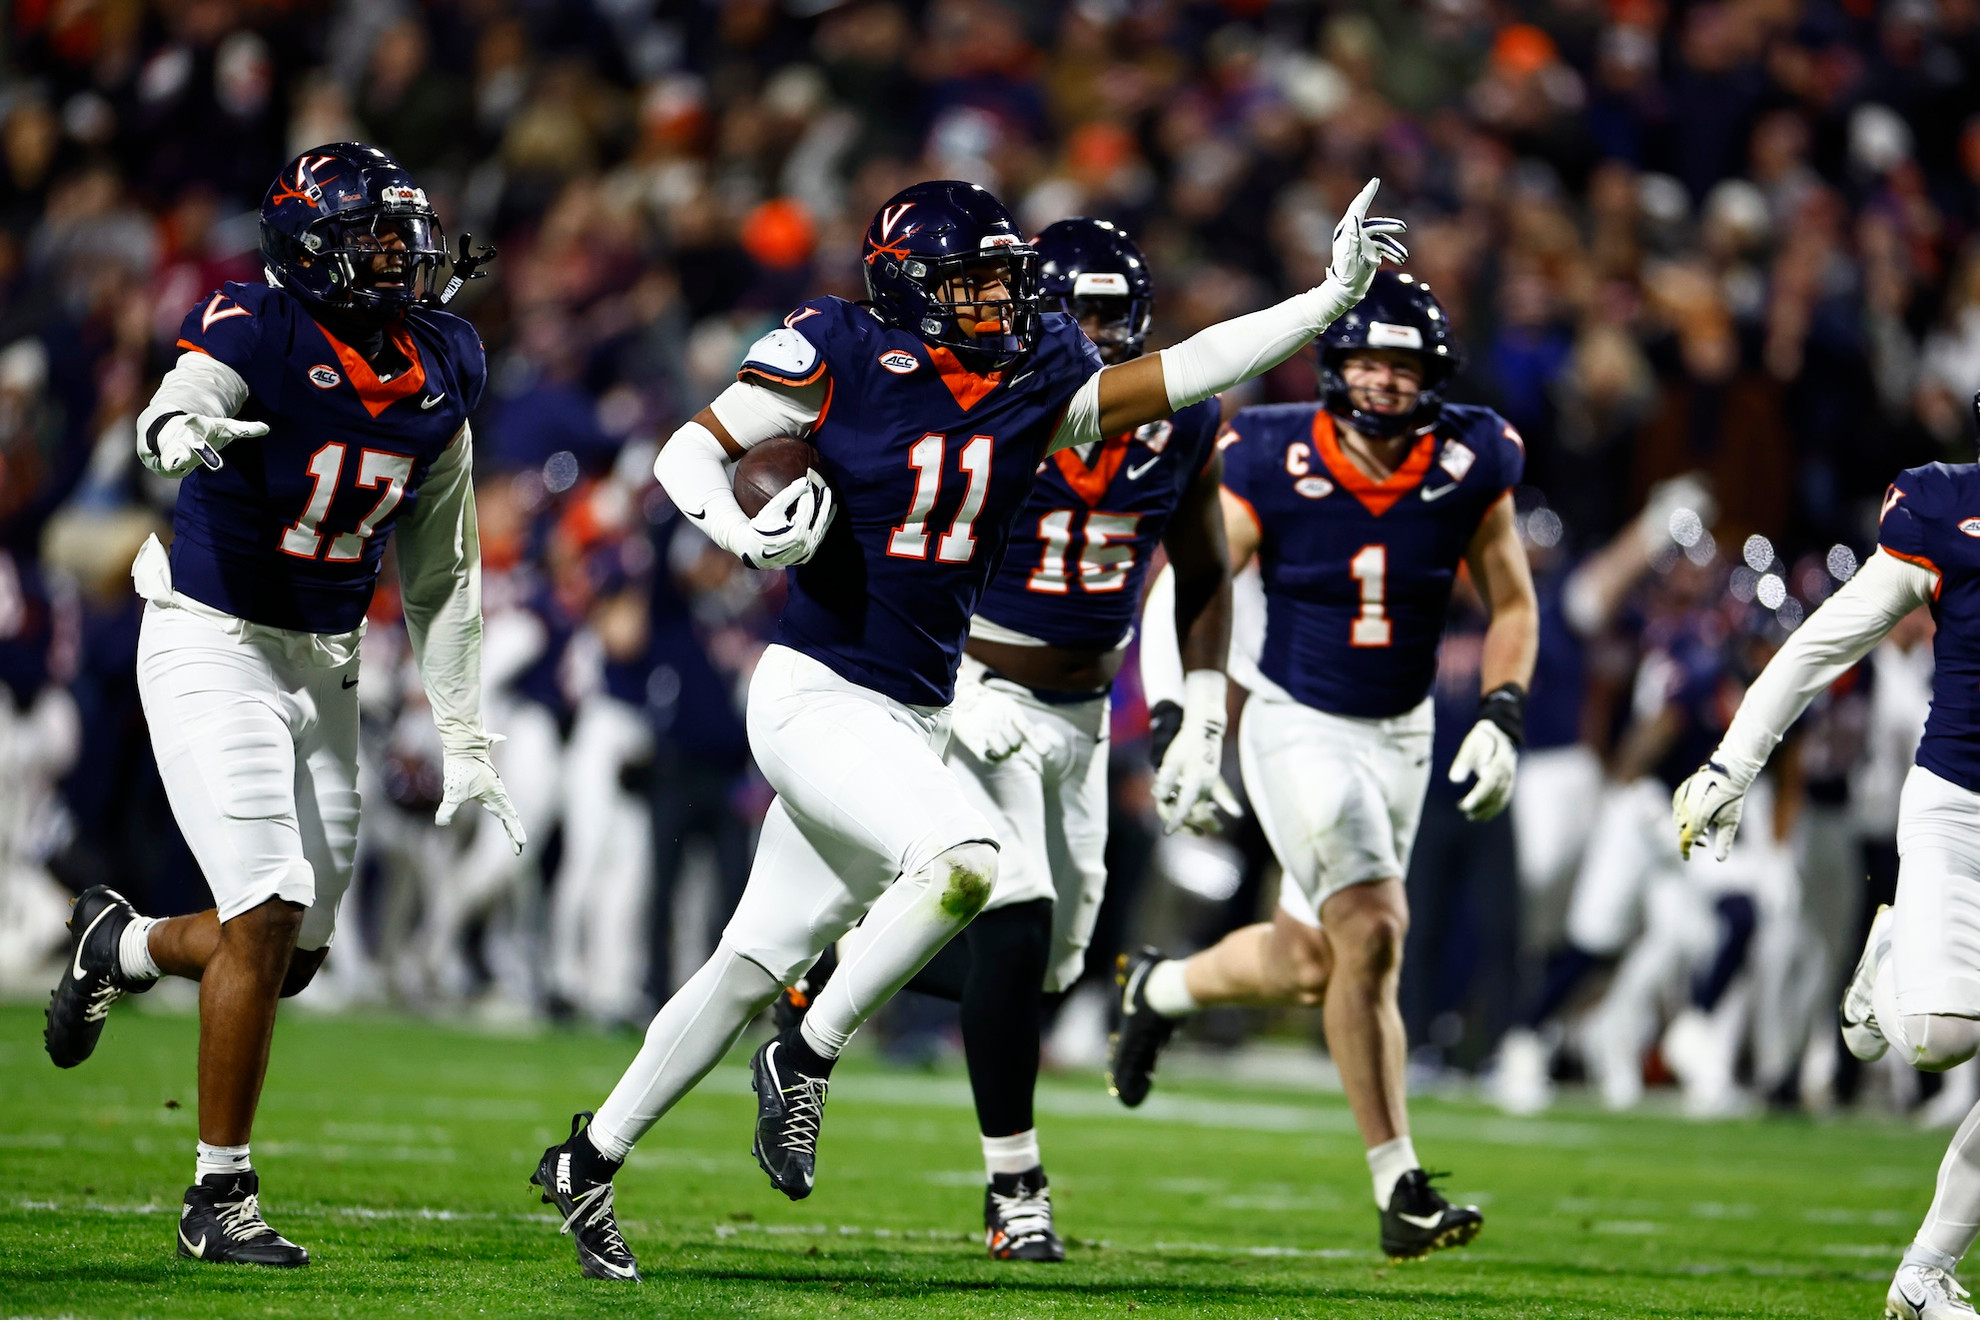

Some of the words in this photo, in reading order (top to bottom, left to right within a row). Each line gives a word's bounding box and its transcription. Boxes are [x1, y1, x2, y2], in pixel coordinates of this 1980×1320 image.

[202, 292, 254, 334] V
[311, 370, 337, 383] ACC
[885, 355, 914, 368] ACC
[1286, 441, 1310, 477] C
[276, 441, 416, 563] 17
[886, 432, 994, 564] 11
[1349, 543, 1395, 649] 1
[556, 1152, 573, 1195] NIKE
